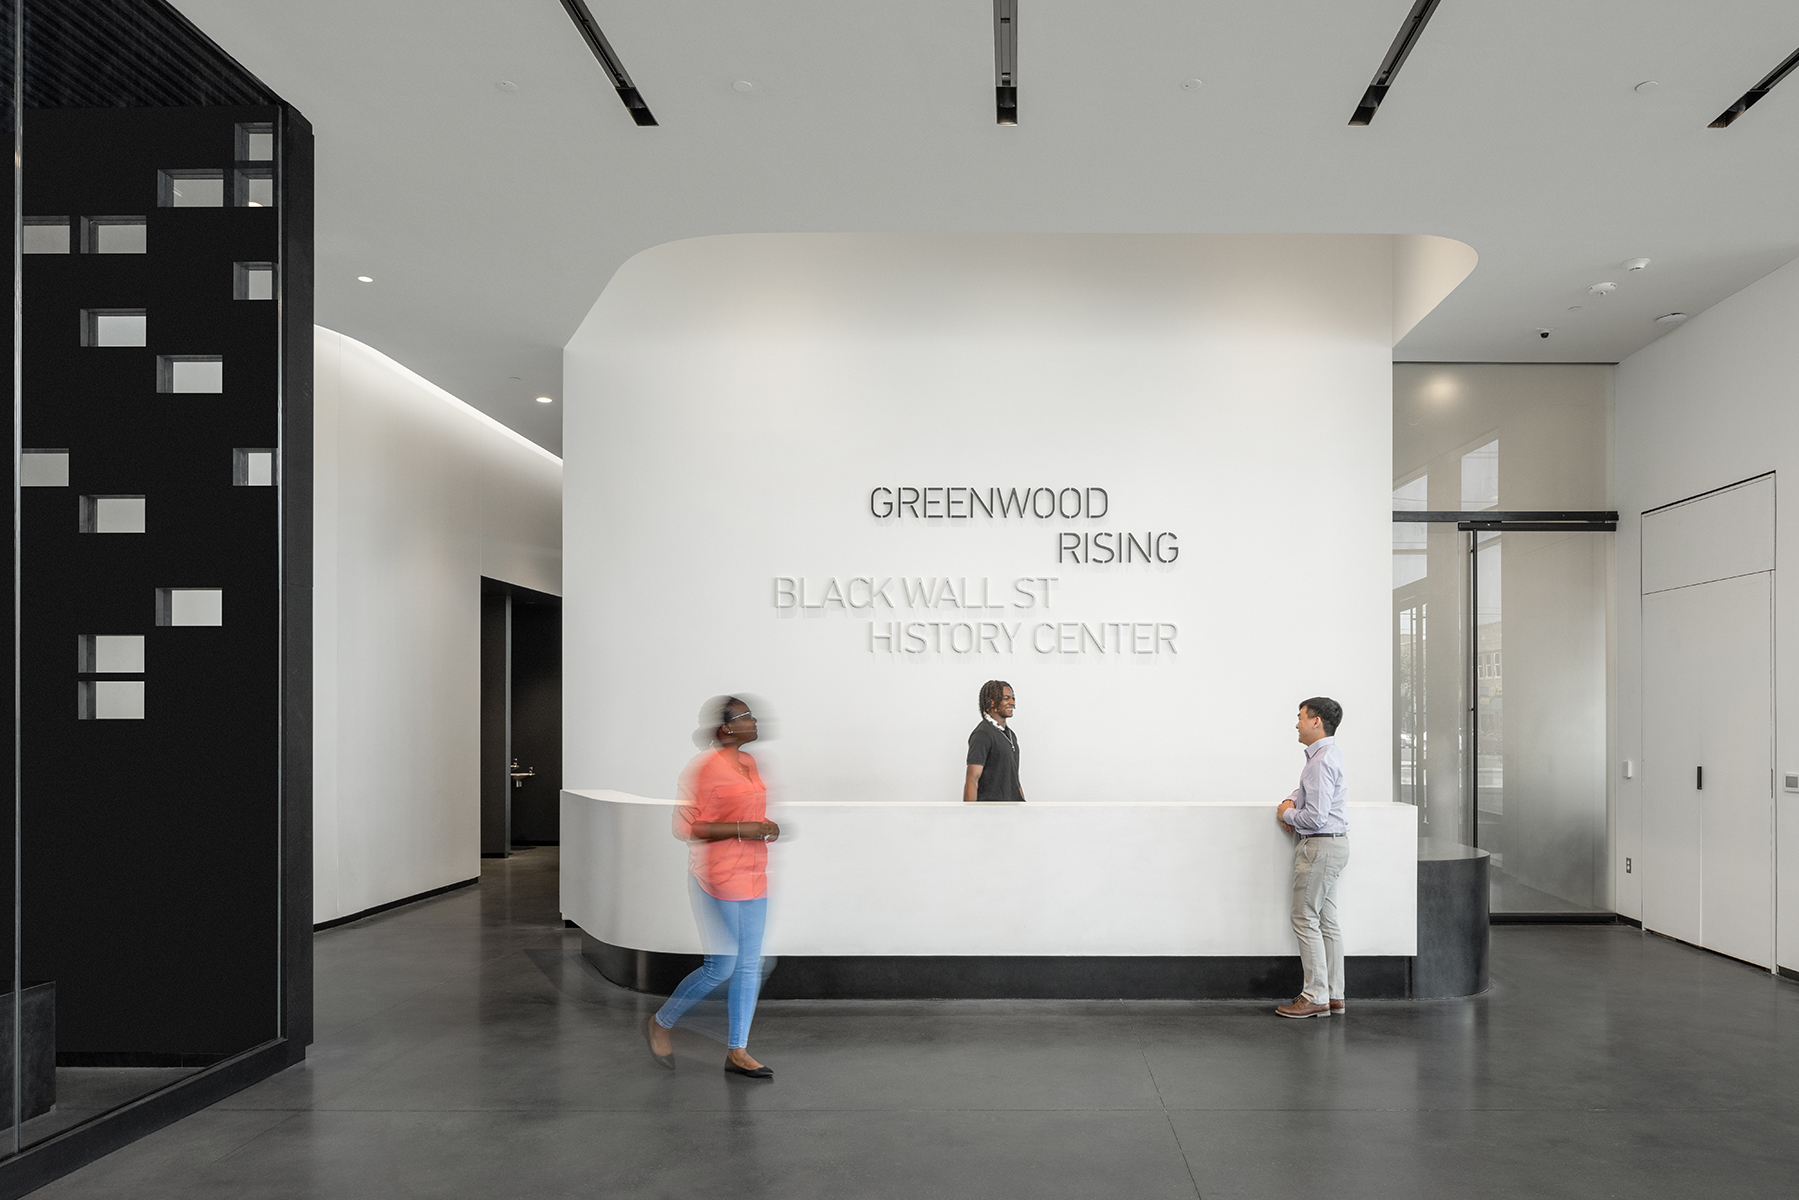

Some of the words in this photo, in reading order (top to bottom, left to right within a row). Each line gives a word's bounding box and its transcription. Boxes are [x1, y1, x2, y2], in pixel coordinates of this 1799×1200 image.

[870, 487, 1109, 519] GREENWOOD
[1058, 531, 1180, 564] RISING
[773, 577, 895, 609] BLACK
[901, 577, 1005, 609] WALL
[1013, 577, 1059, 609] ST
[869, 621, 1023, 654] HISTORY
[1033, 622, 1179, 654] CENTER
